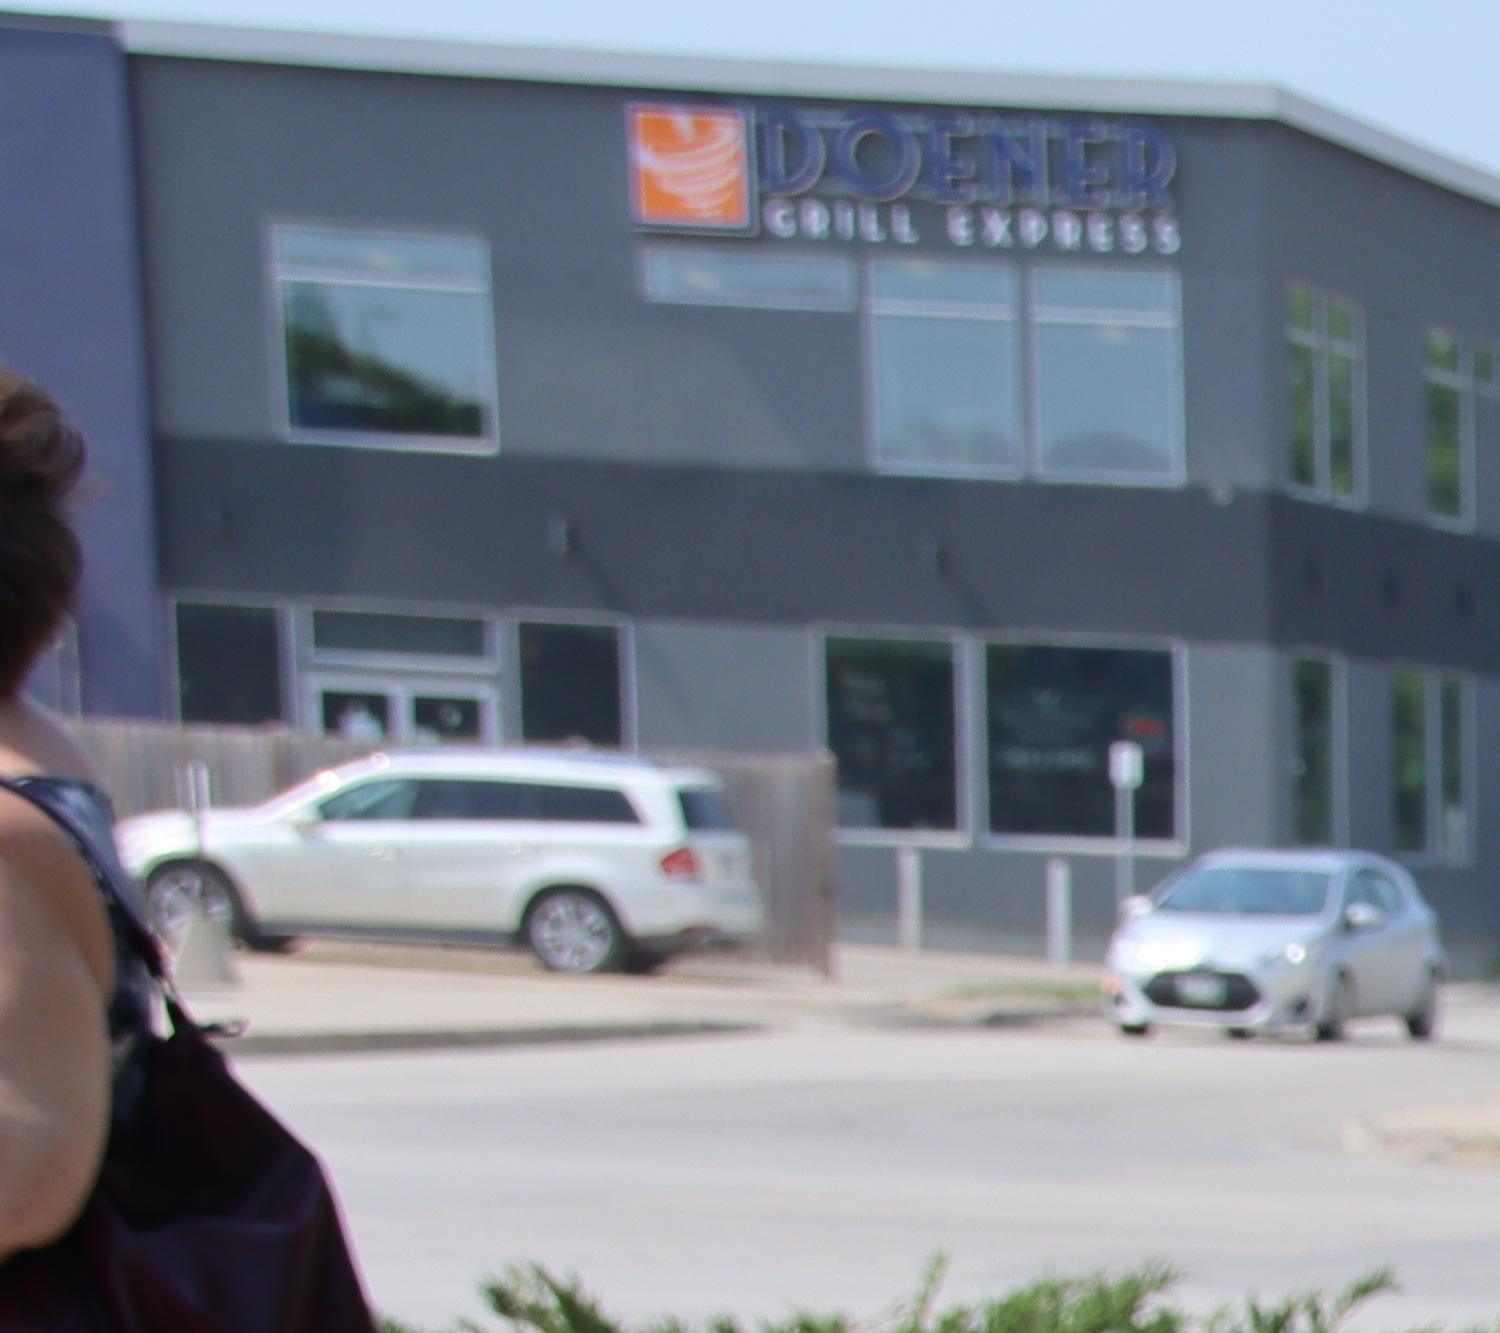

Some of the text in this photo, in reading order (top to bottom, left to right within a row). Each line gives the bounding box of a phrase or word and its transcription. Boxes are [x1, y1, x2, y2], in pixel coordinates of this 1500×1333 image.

[757, 108, 1177, 213] DOENER
[763, 199, 1182, 255] GRILL EXPRESS
